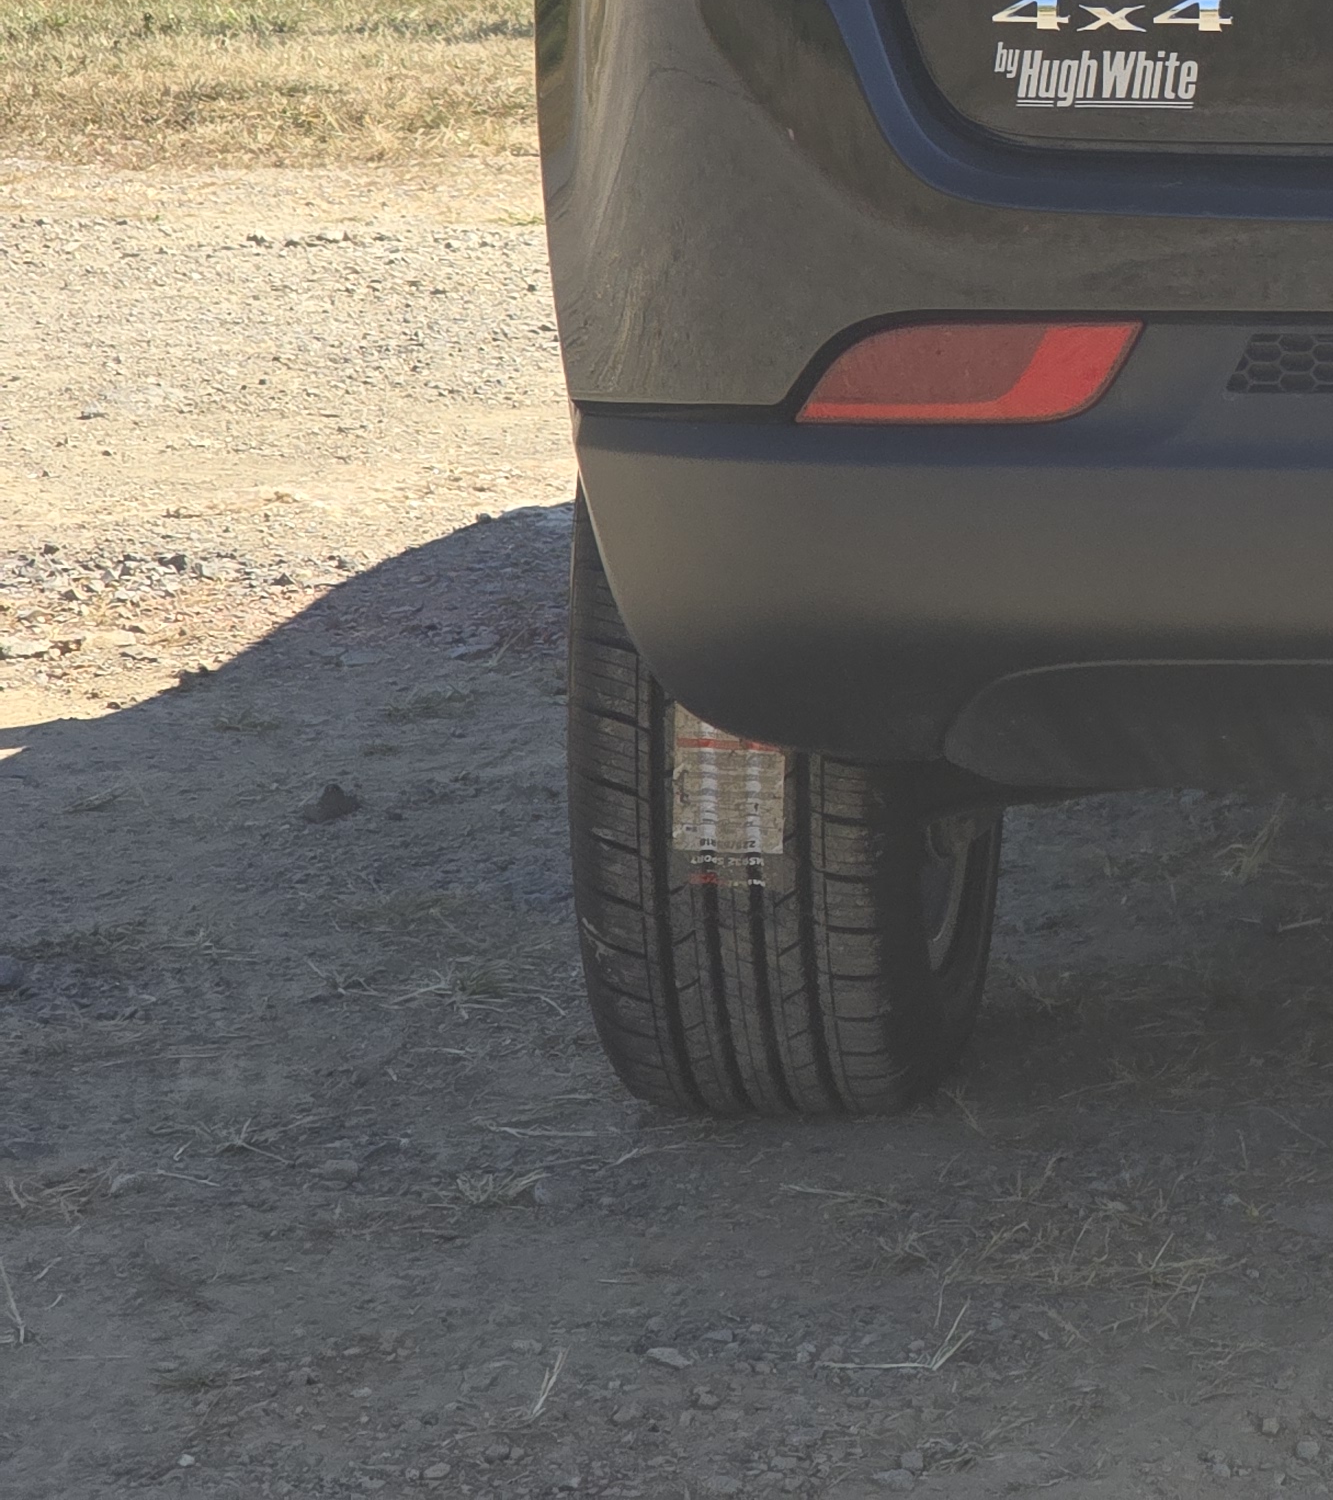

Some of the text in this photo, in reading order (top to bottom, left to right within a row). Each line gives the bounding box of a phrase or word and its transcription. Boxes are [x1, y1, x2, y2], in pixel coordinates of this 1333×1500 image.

[994, 42, 1199, 107] by Hugh White
